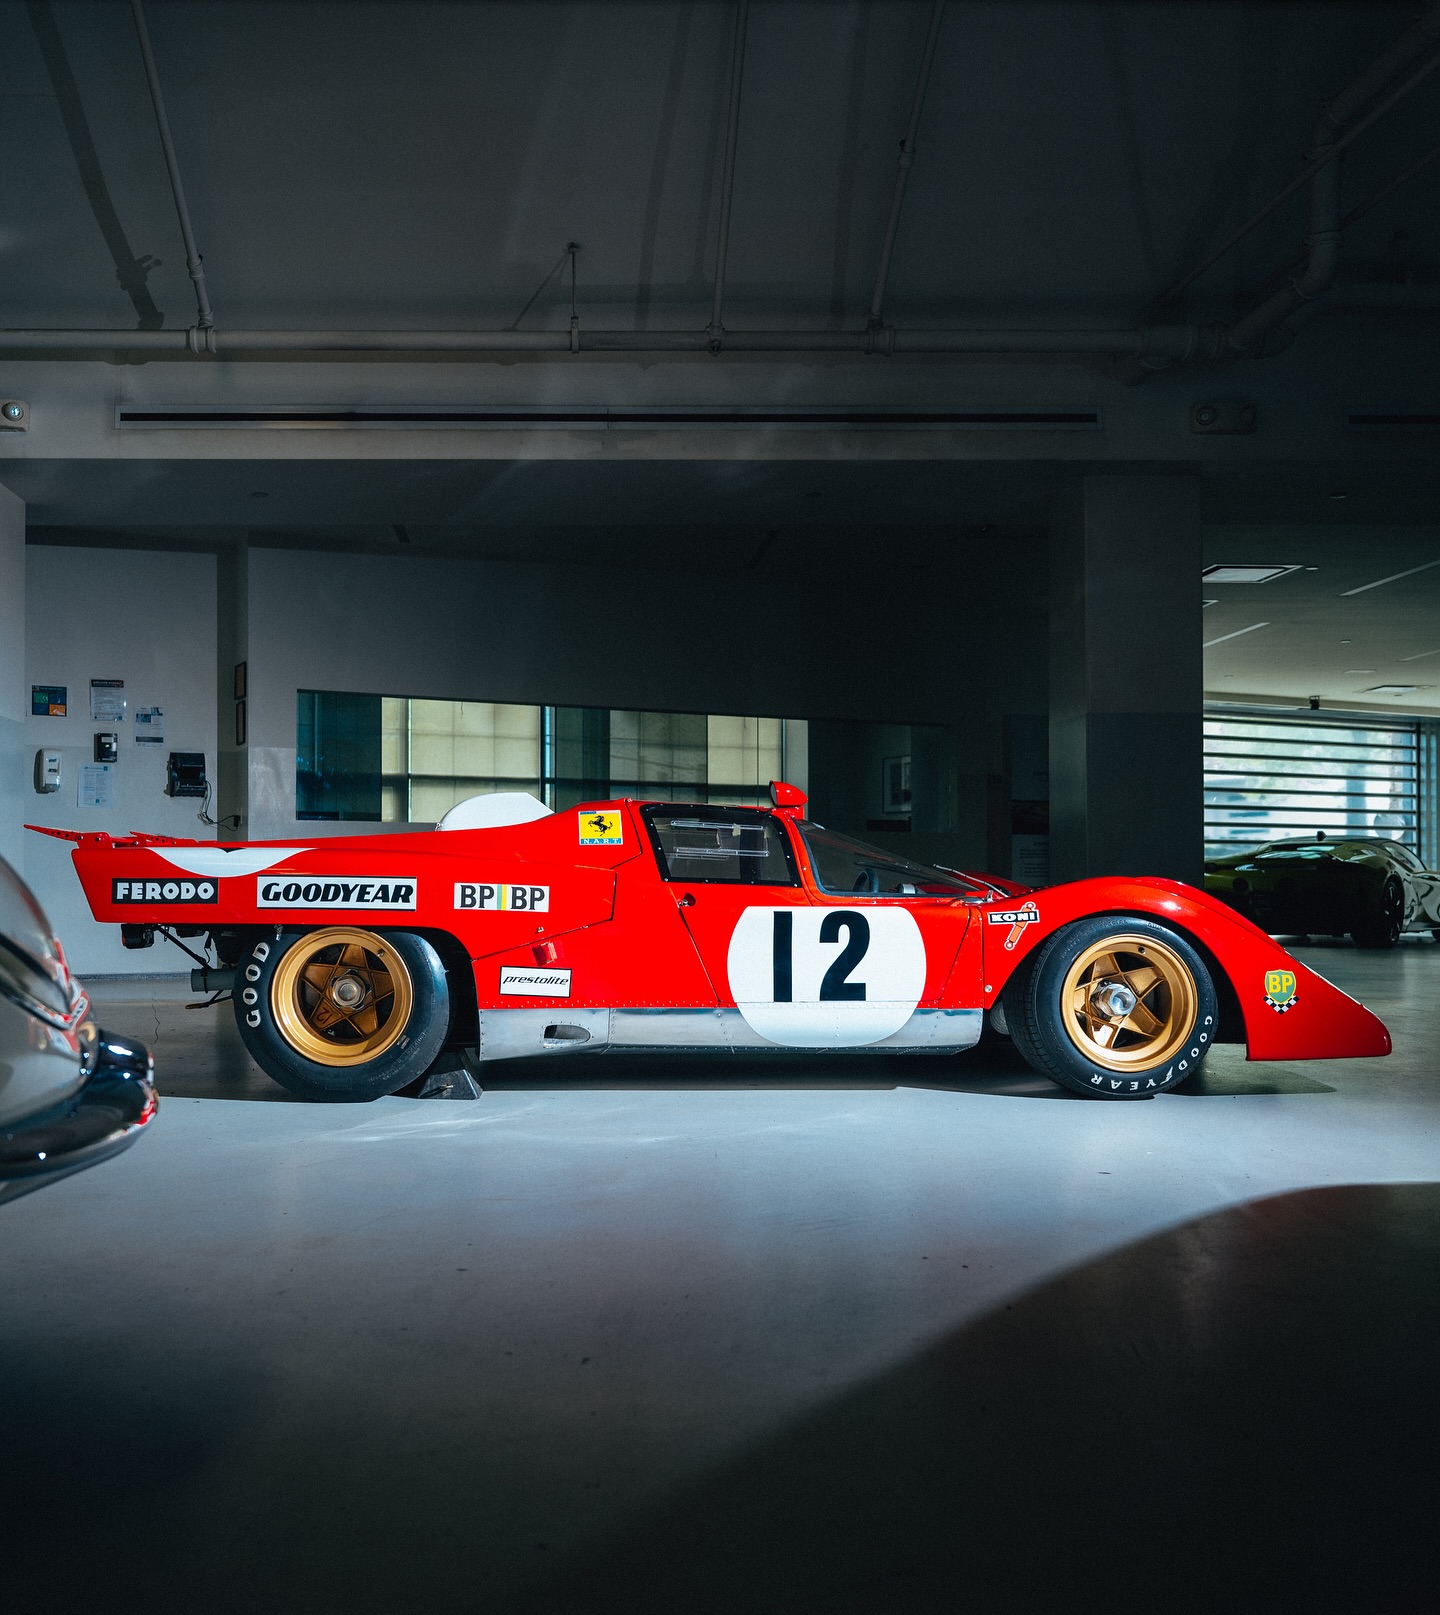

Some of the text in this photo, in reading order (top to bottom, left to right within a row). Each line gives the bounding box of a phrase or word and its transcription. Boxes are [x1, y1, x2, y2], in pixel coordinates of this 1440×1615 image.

[115, 882, 215, 900] FERODO
[261, 883, 414, 903] GOODYEAR
[459, 884, 545, 910] BP BP
[991, 913, 1036, 922] KONI
[772, 910, 871, 1003] 12
[502, 975, 569, 985] prestolite
[1268, 973, 1294, 994] BP
